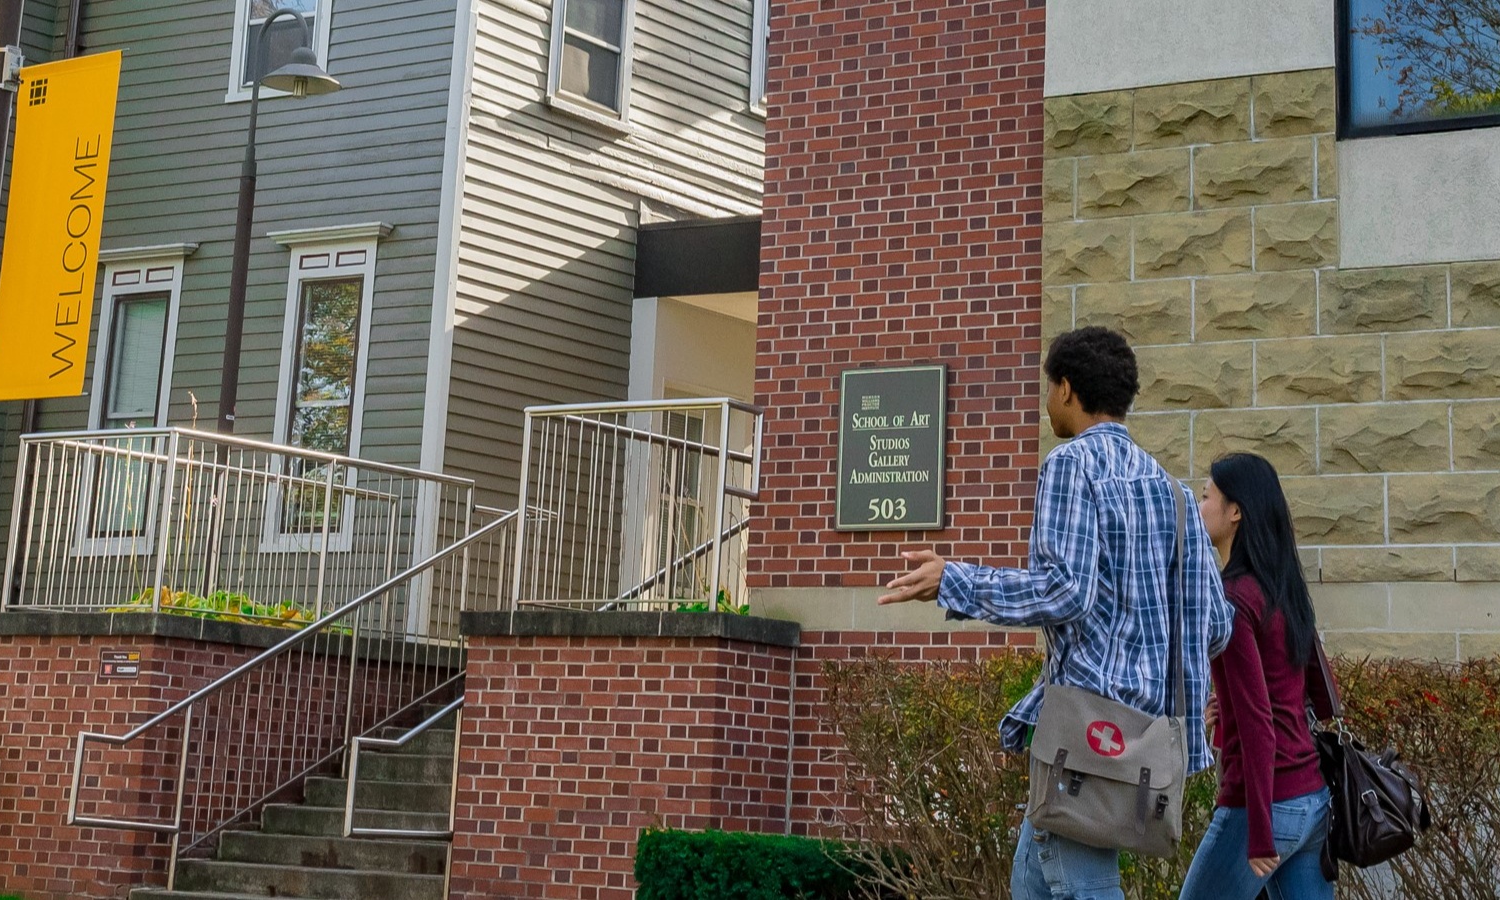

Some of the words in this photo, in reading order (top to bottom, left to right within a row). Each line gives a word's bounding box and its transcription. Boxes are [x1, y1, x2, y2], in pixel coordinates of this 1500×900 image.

[48, 133, 101, 379] WELCOME
[852, 413, 889, 428] SCHOOL
[892, 415, 905, 427] OF
[910, 410, 930, 427] ART
[870, 435, 910, 450] STUDIOS
[869, 452, 910, 467] GALLERY
[849, 469, 929, 484] ADMINISTRATION
[867, 498, 907, 521] 503
